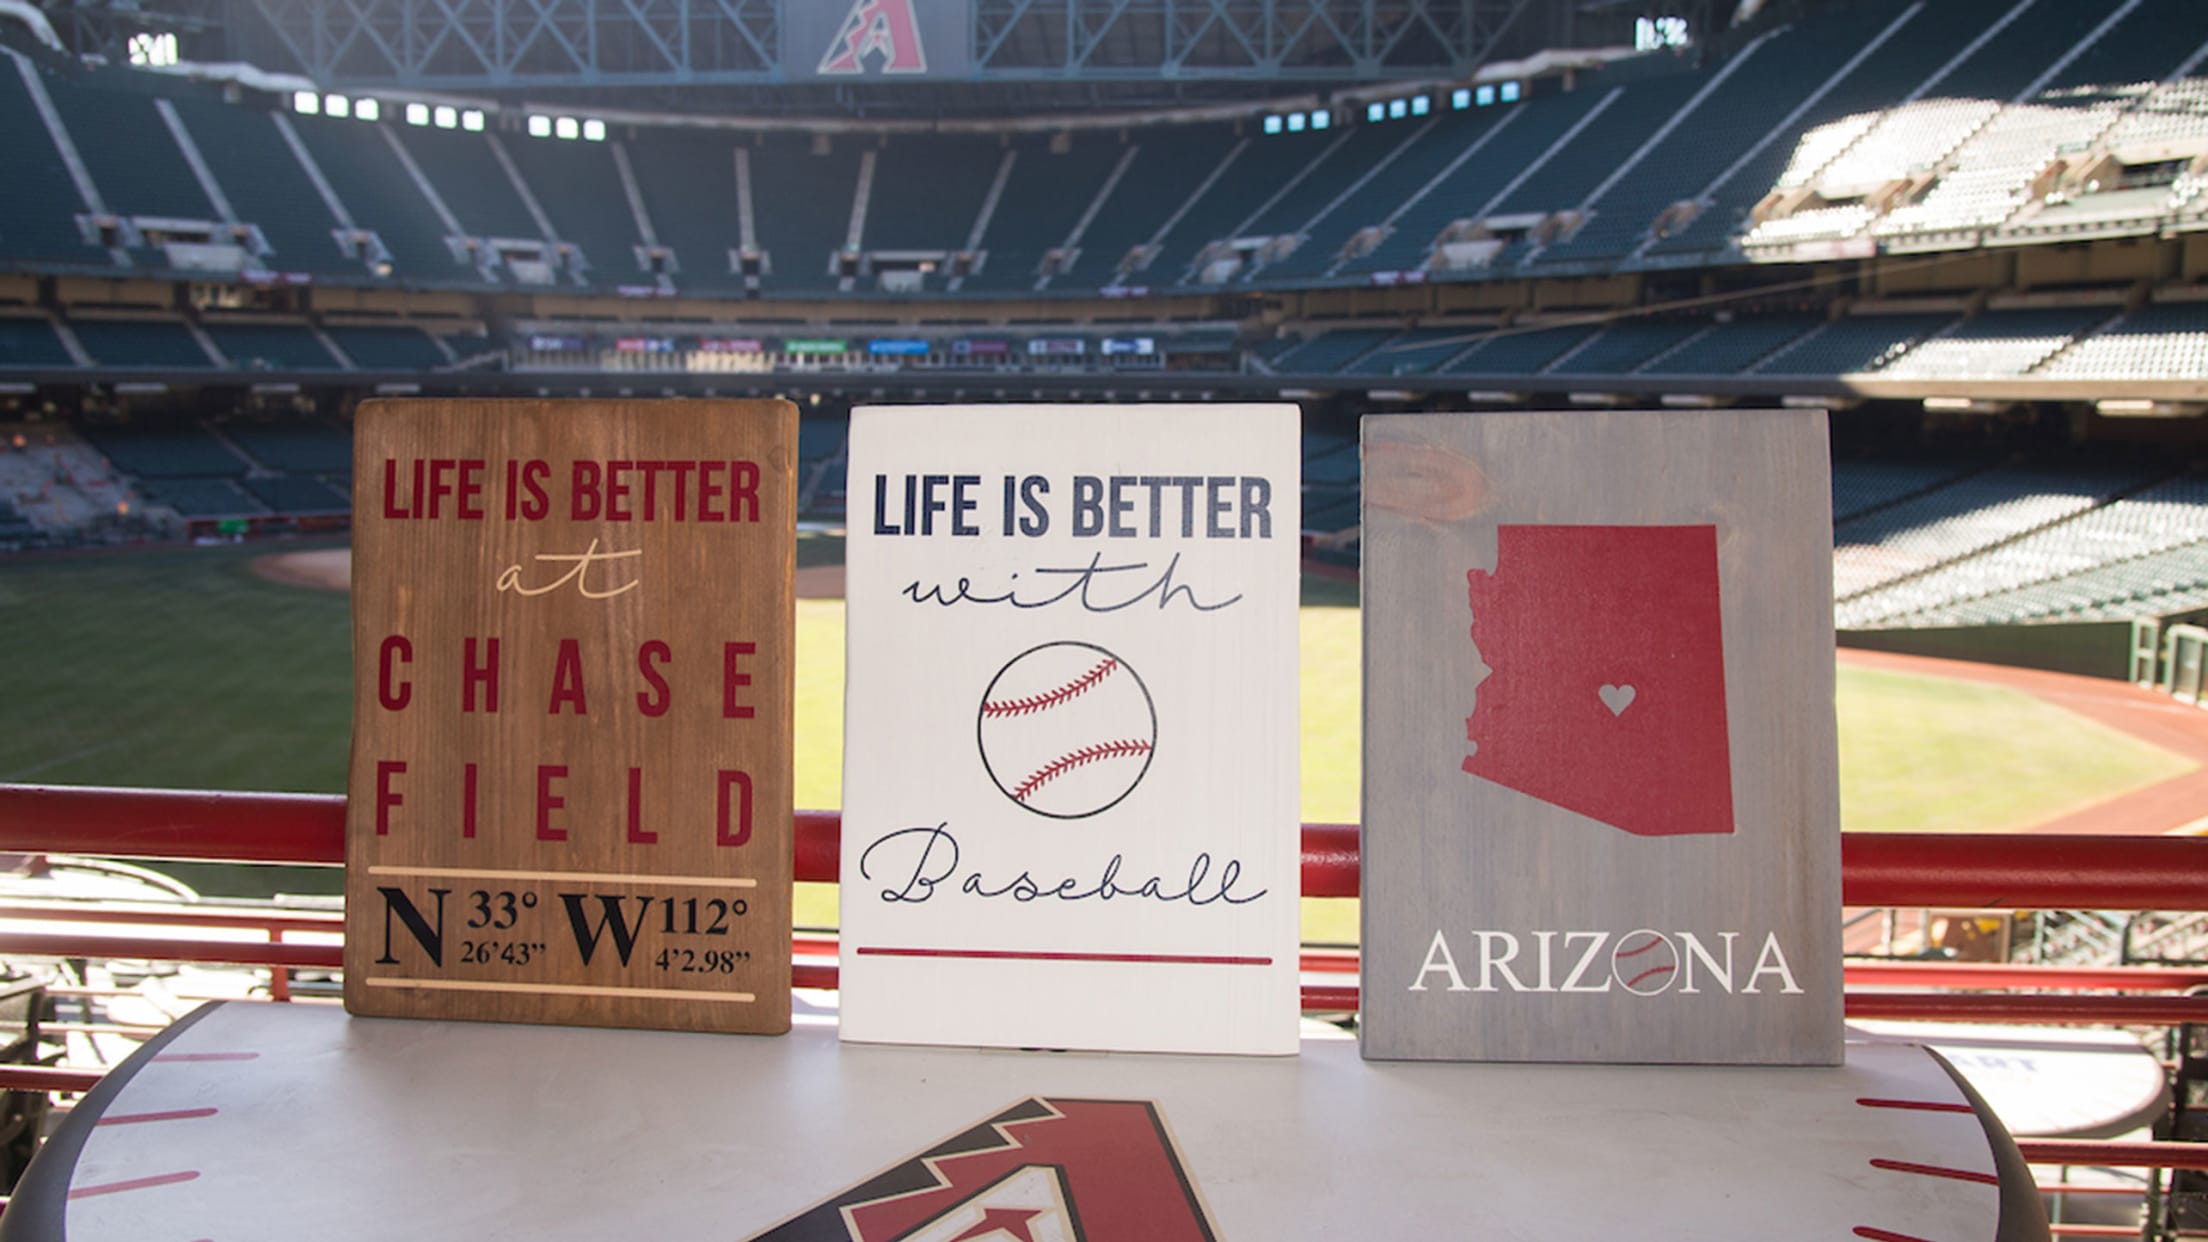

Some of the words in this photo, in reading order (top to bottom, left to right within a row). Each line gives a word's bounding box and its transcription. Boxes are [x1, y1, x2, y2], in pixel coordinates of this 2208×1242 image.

[383, 459, 486, 520] LIFE
[506, 459, 550, 521] IS
[571, 460, 760, 522] BETTER
[873, 474, 981, 537] LIFE
[1002, 475, 1050, 538] IS
[1072, 476, 1272, 539] BETTER
[497, 539, 642, 598] at
[902, 551, 1243, 613] with
[860, 821, 1268, 906] Baseball
[375, 887, 452, 968] N
[558, 893, 655, 968] W
[1408, 928, 1804, 997] ARIZONA
